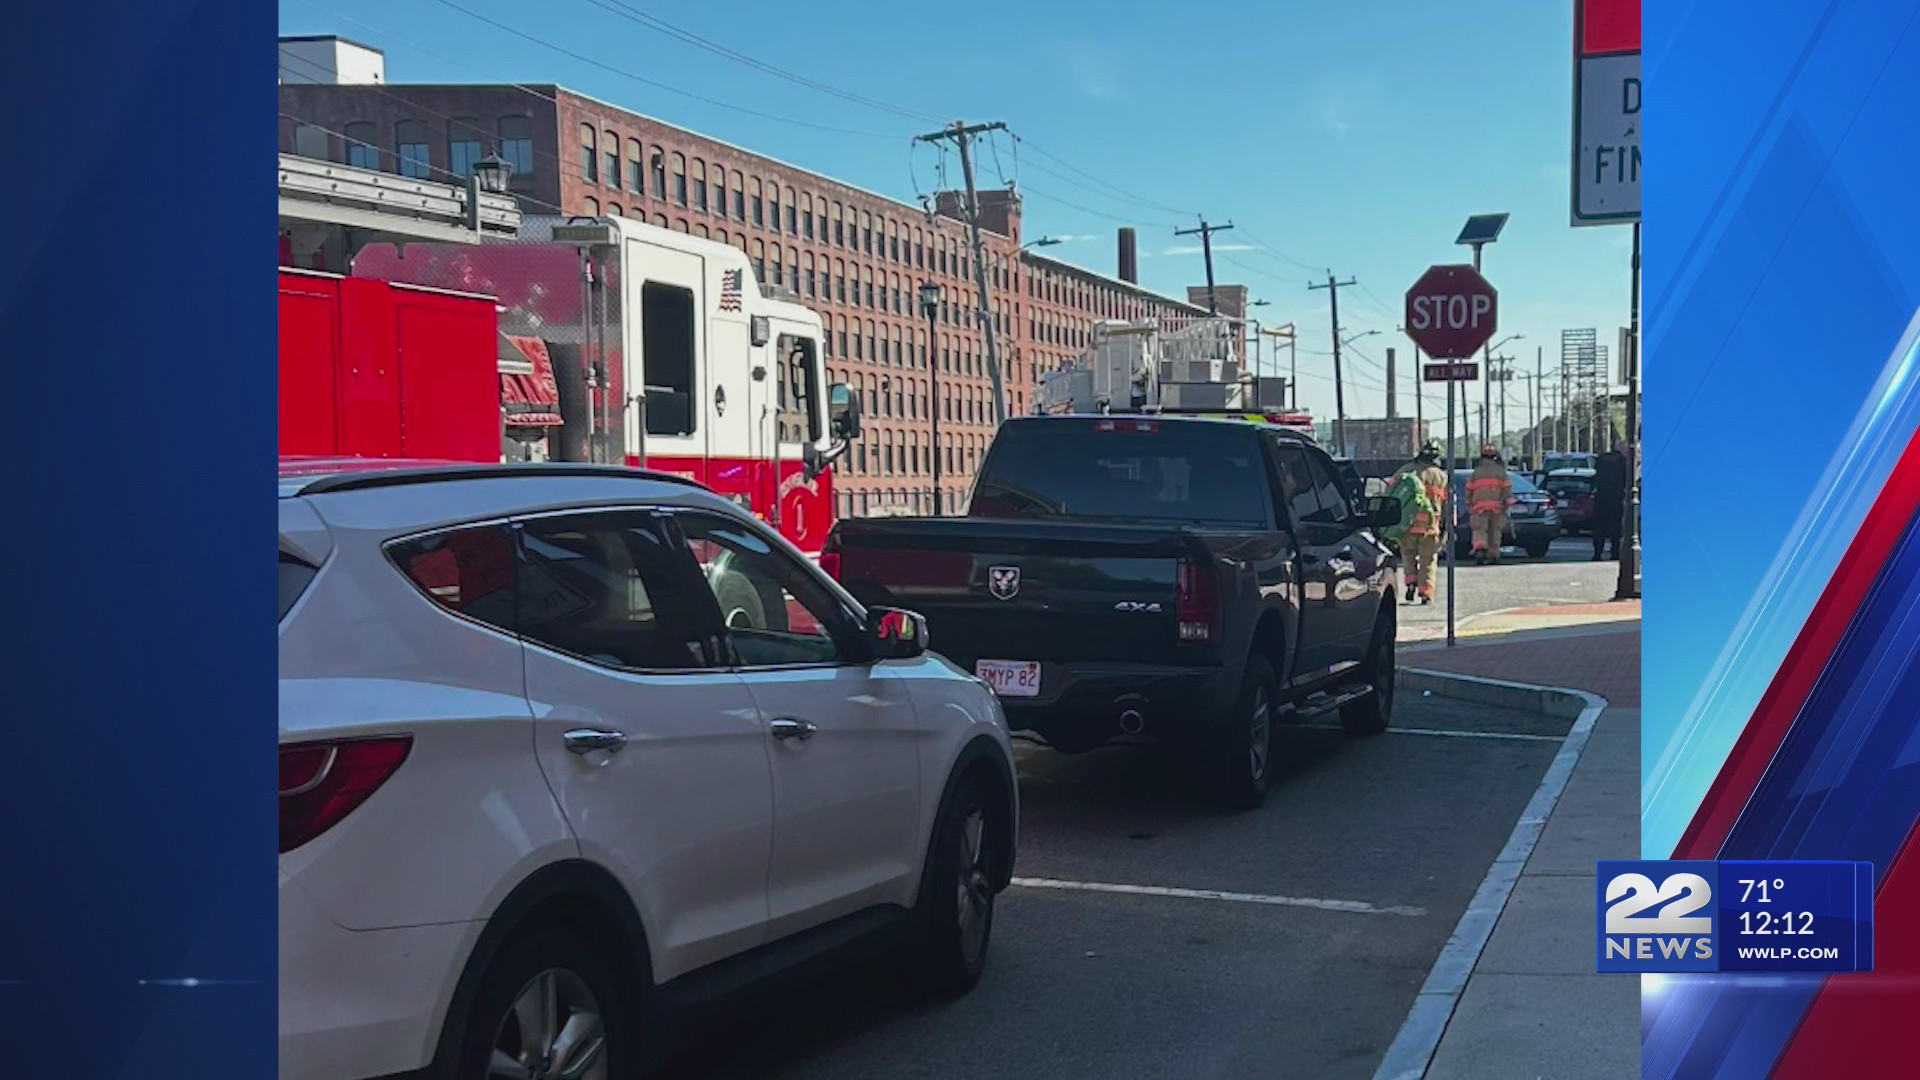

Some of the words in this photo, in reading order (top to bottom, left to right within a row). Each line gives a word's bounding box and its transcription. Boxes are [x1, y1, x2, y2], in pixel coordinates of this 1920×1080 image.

[1411, 294, 1491, 330] STOP
[1428, 366, 1447, 378] ALL
[1451, 365, 1473, 378] WAY
[1019, 669, 1036, 687] 82
